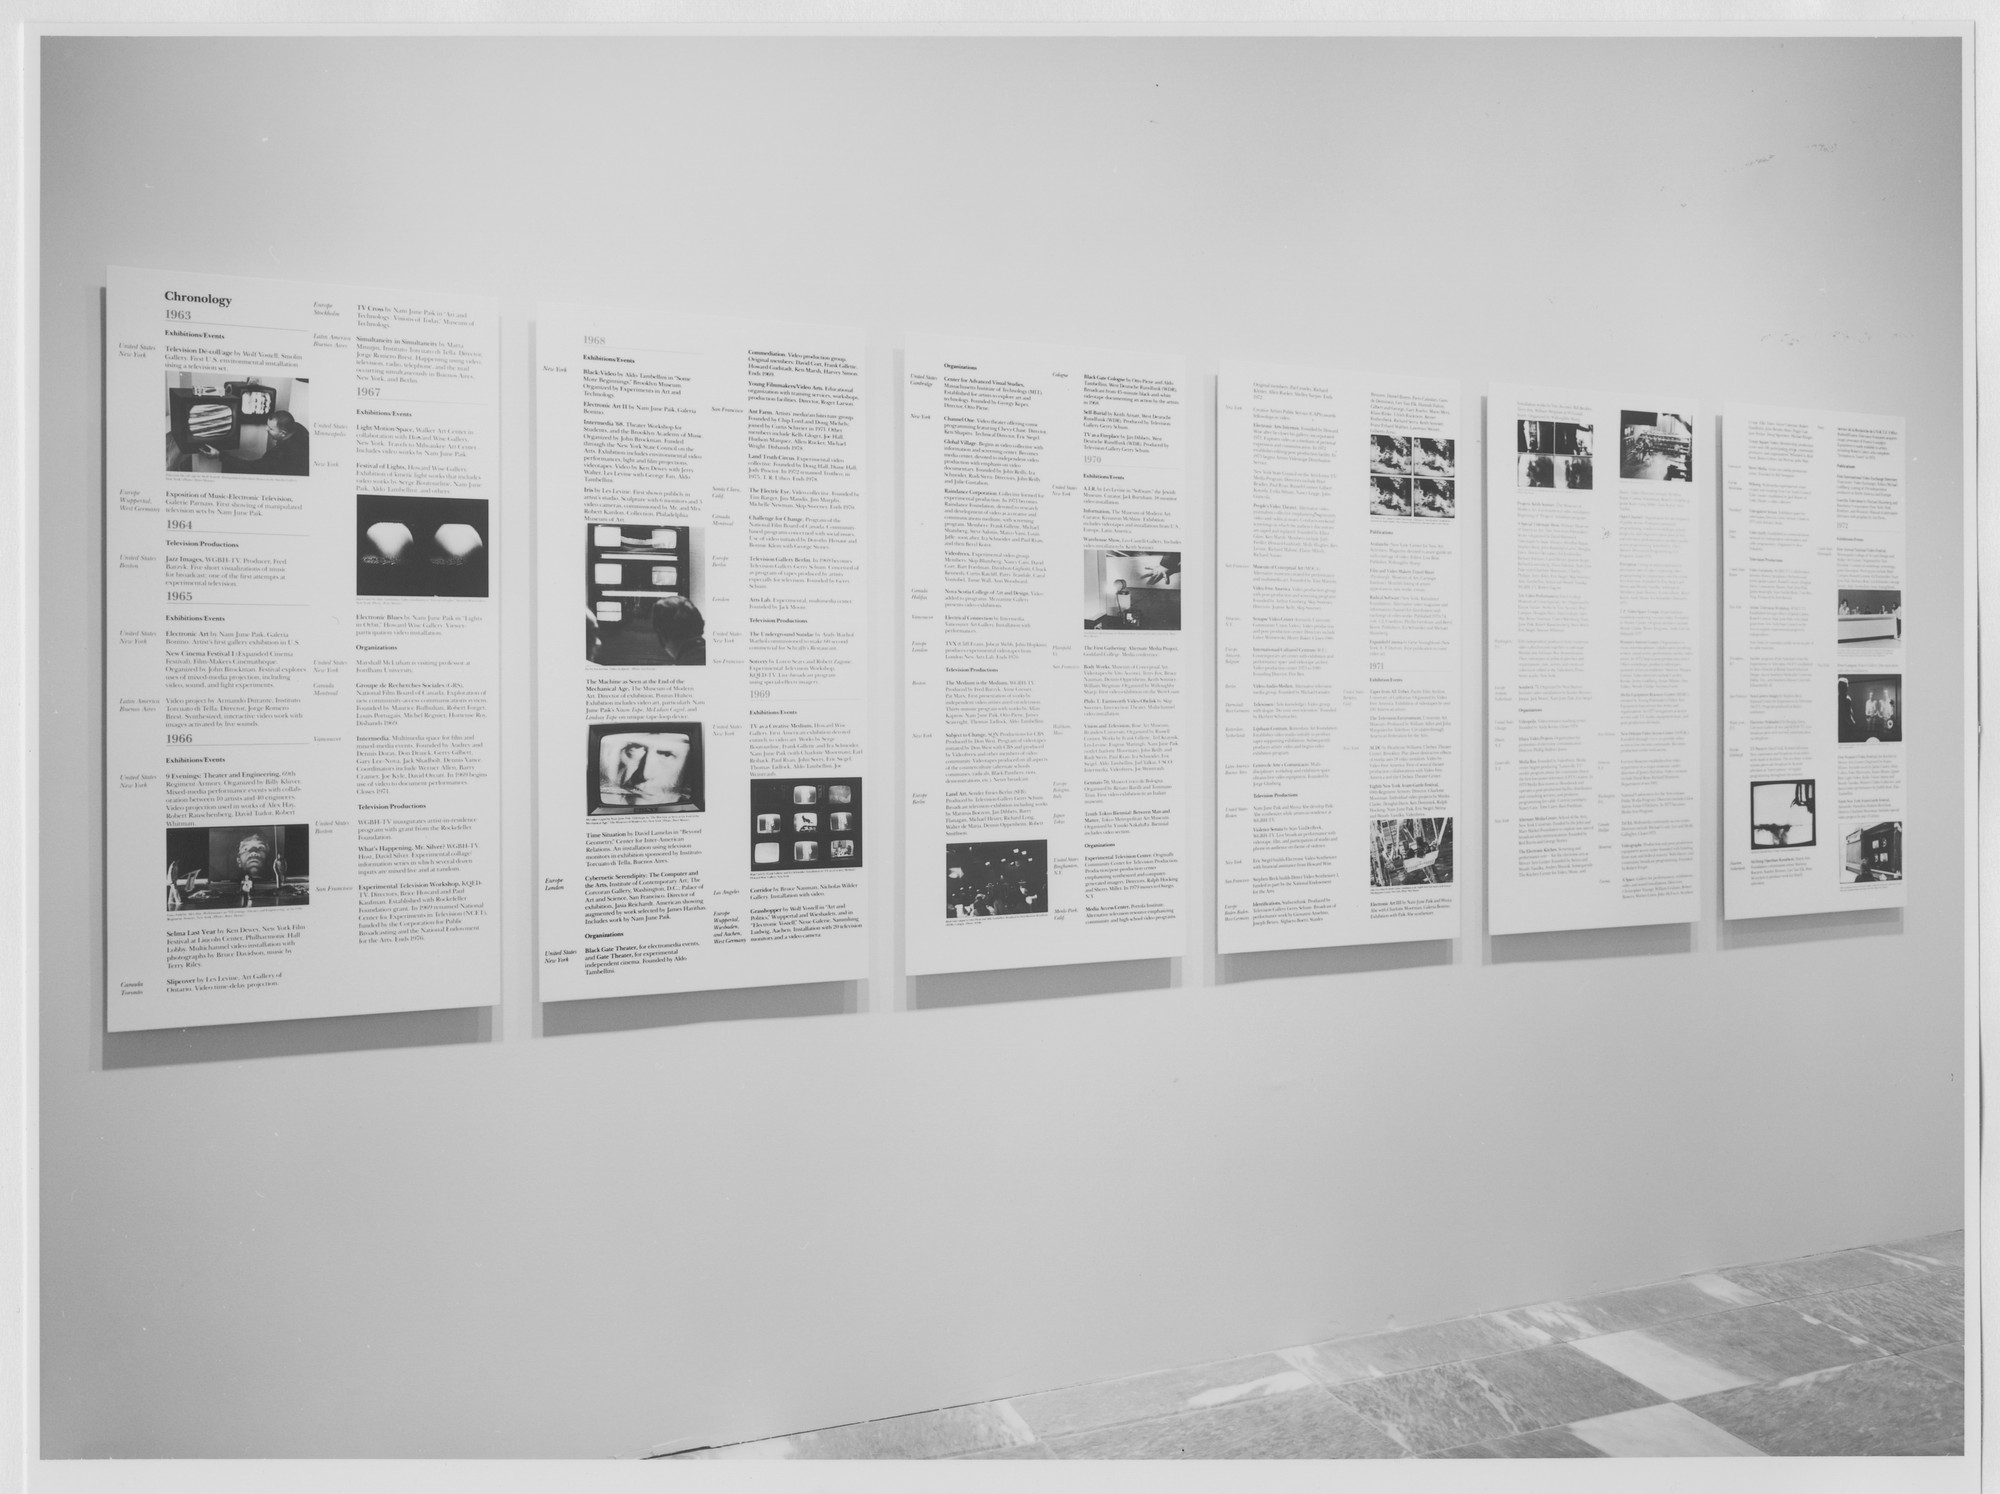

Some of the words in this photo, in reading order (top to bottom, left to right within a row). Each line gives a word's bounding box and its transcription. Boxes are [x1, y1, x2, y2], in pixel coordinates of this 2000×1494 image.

[164, 291, 232, 307] Chronology
[166, 309, 191, 321] 1963
[584, 335, 605, 346] 1968
[943, 362, 977, 372] Organizations
[357, 386, 380, 397] 1967
[1084, 455, 1102, 464] 1970
[167, 518, 192, 529] 1964
[167, 590, 192, 602] 1965
[355, 644, 397, 653] Organizations
[1369, 662, 1384, 670] 1971
[750, 690, 770, 699] 1969
[167, 733, 192, 744] 1966
[584, 930, 624, 941] Organizations
